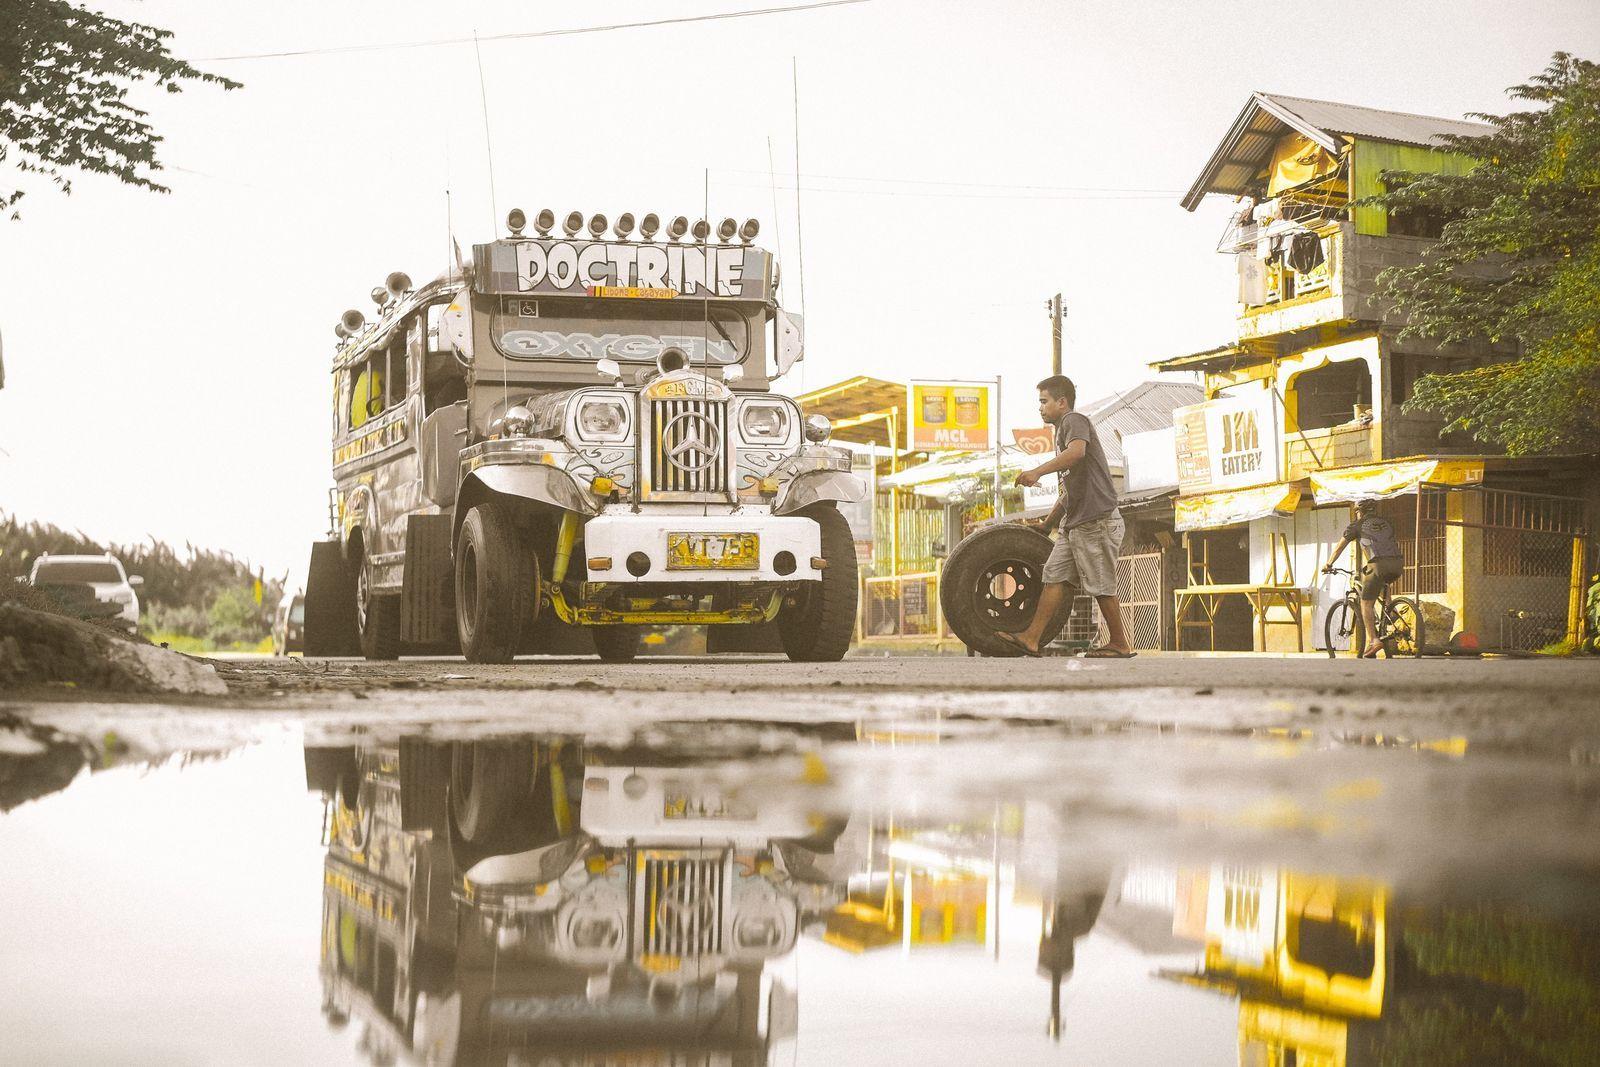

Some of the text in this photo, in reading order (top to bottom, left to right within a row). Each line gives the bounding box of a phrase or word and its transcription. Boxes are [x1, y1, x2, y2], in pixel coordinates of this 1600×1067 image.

[515, 242, 745, 297] DOCTRINE
[501, 330, 738, 363] OXYGEN
[934, 429, 969, 443] MCL
[1222, 451, 1262, 476] EATERY
